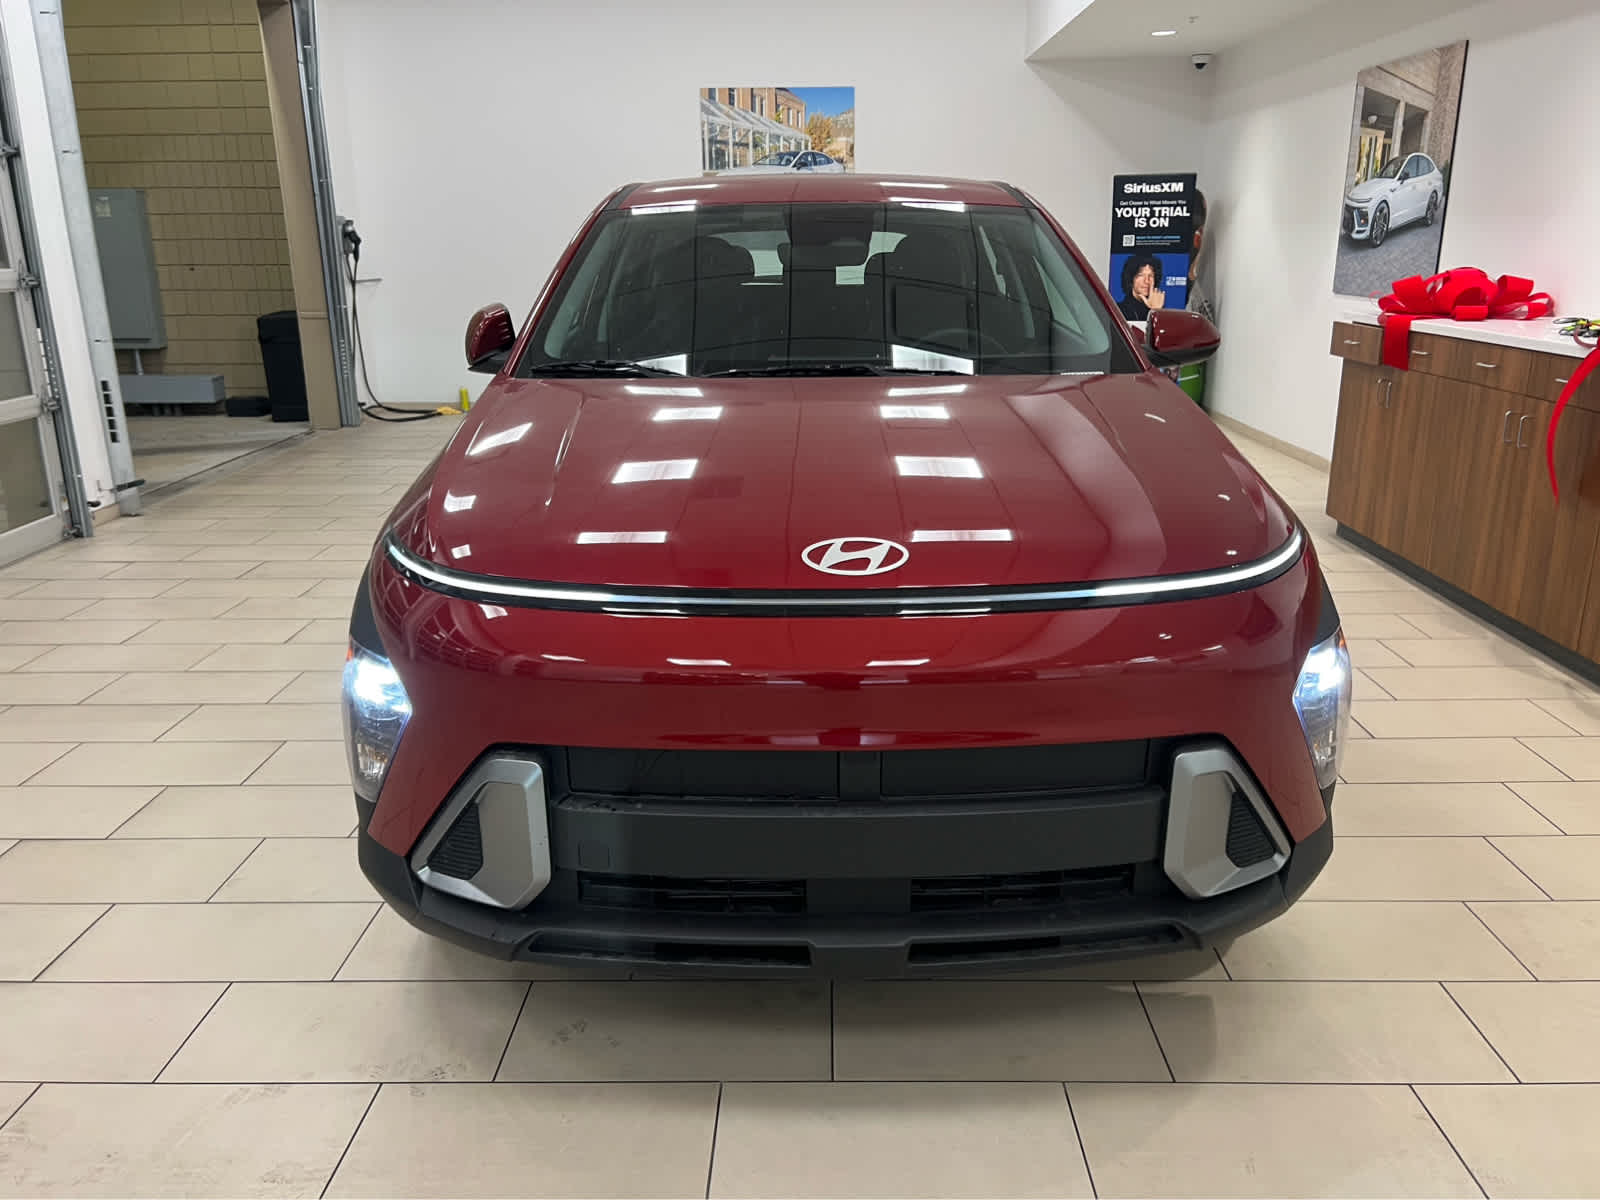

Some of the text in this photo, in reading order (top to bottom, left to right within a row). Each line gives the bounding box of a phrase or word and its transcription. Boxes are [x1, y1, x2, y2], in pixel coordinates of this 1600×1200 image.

[1124, 182, 1184, 194] SiriusXM
[1115, 206, 1190, 218] YOUR TRIAL
[1134, 217, 1169, 228] IS ON
